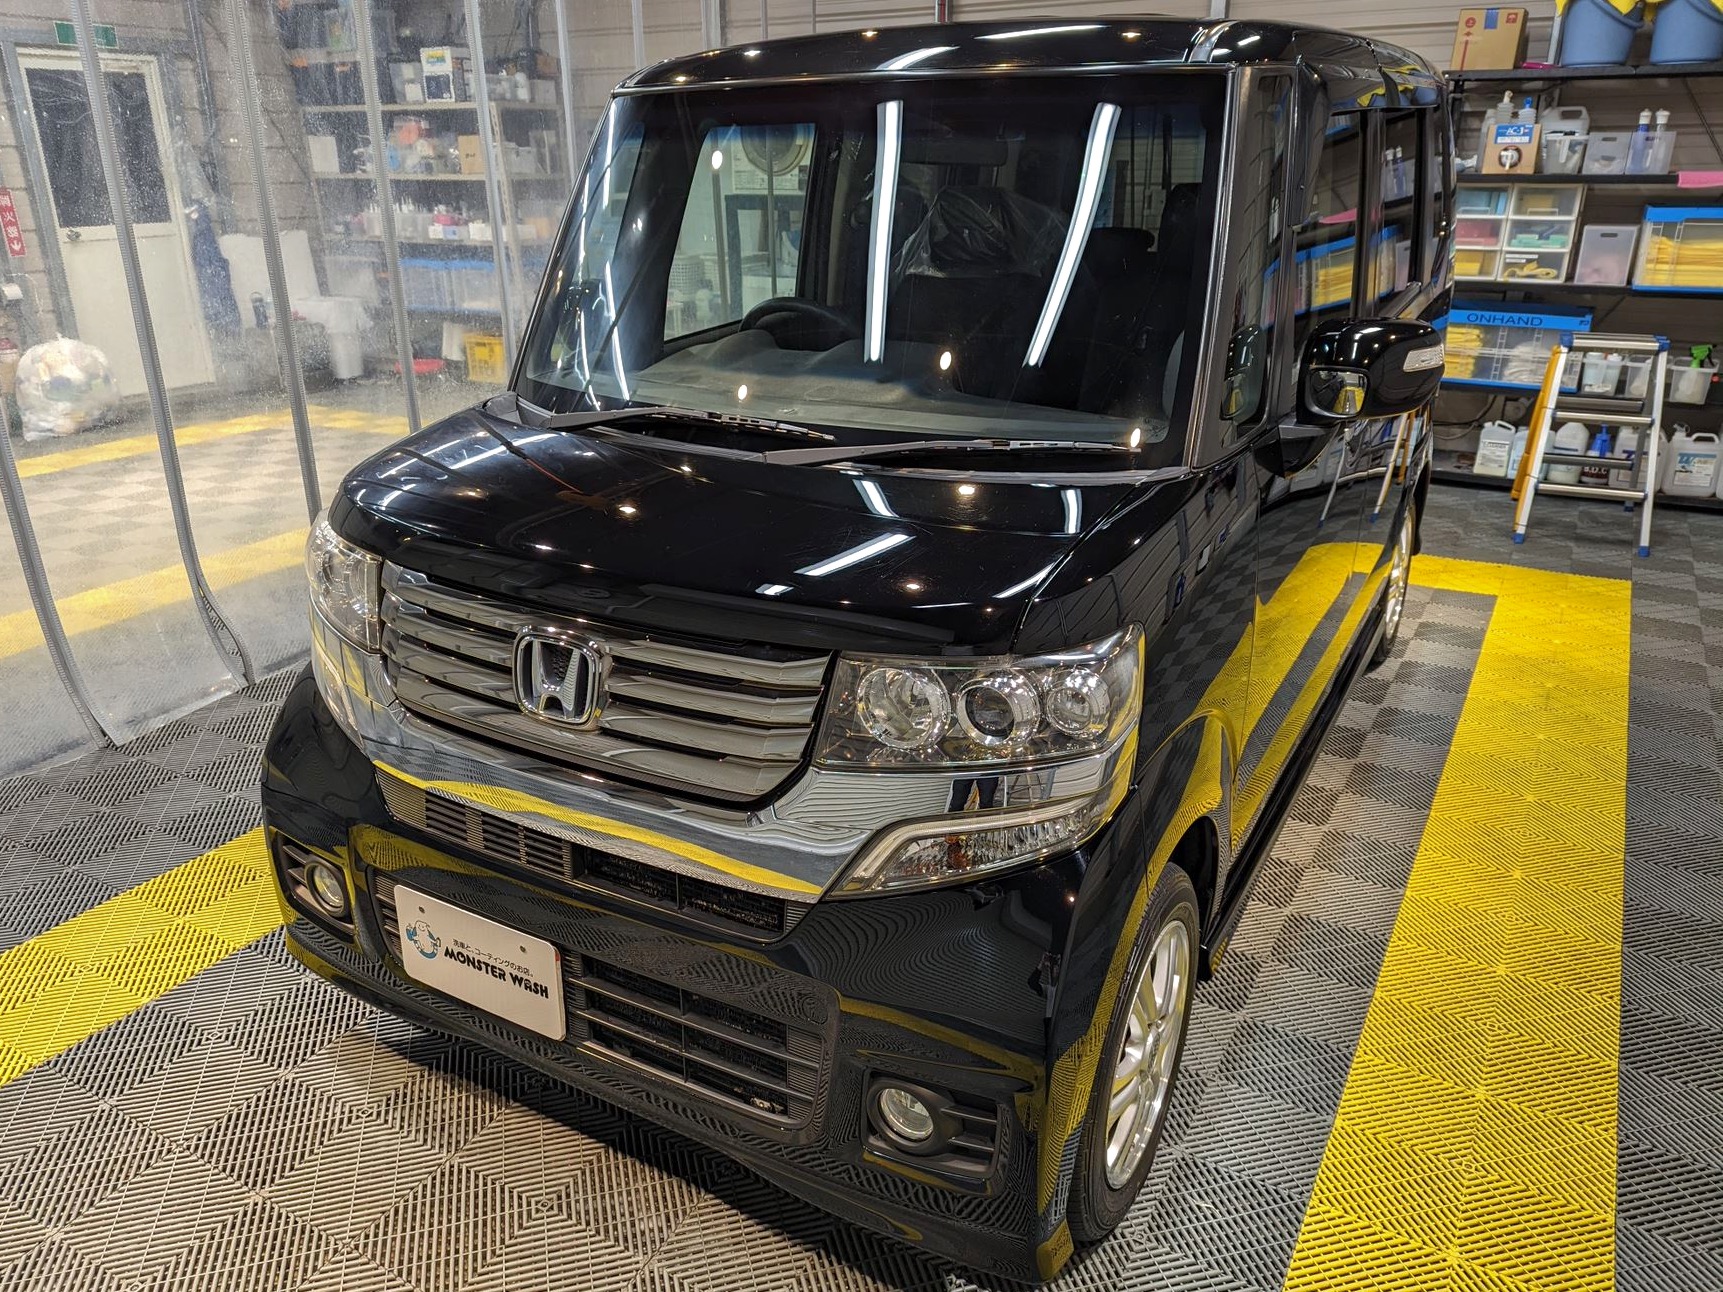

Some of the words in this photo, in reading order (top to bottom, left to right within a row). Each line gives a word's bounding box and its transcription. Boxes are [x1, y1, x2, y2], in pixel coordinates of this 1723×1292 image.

[1466, 312, 1543, 327] ONHAND
[444, 946, 506, 981] MONSTER
[509, 972, 549, 998] WASH
